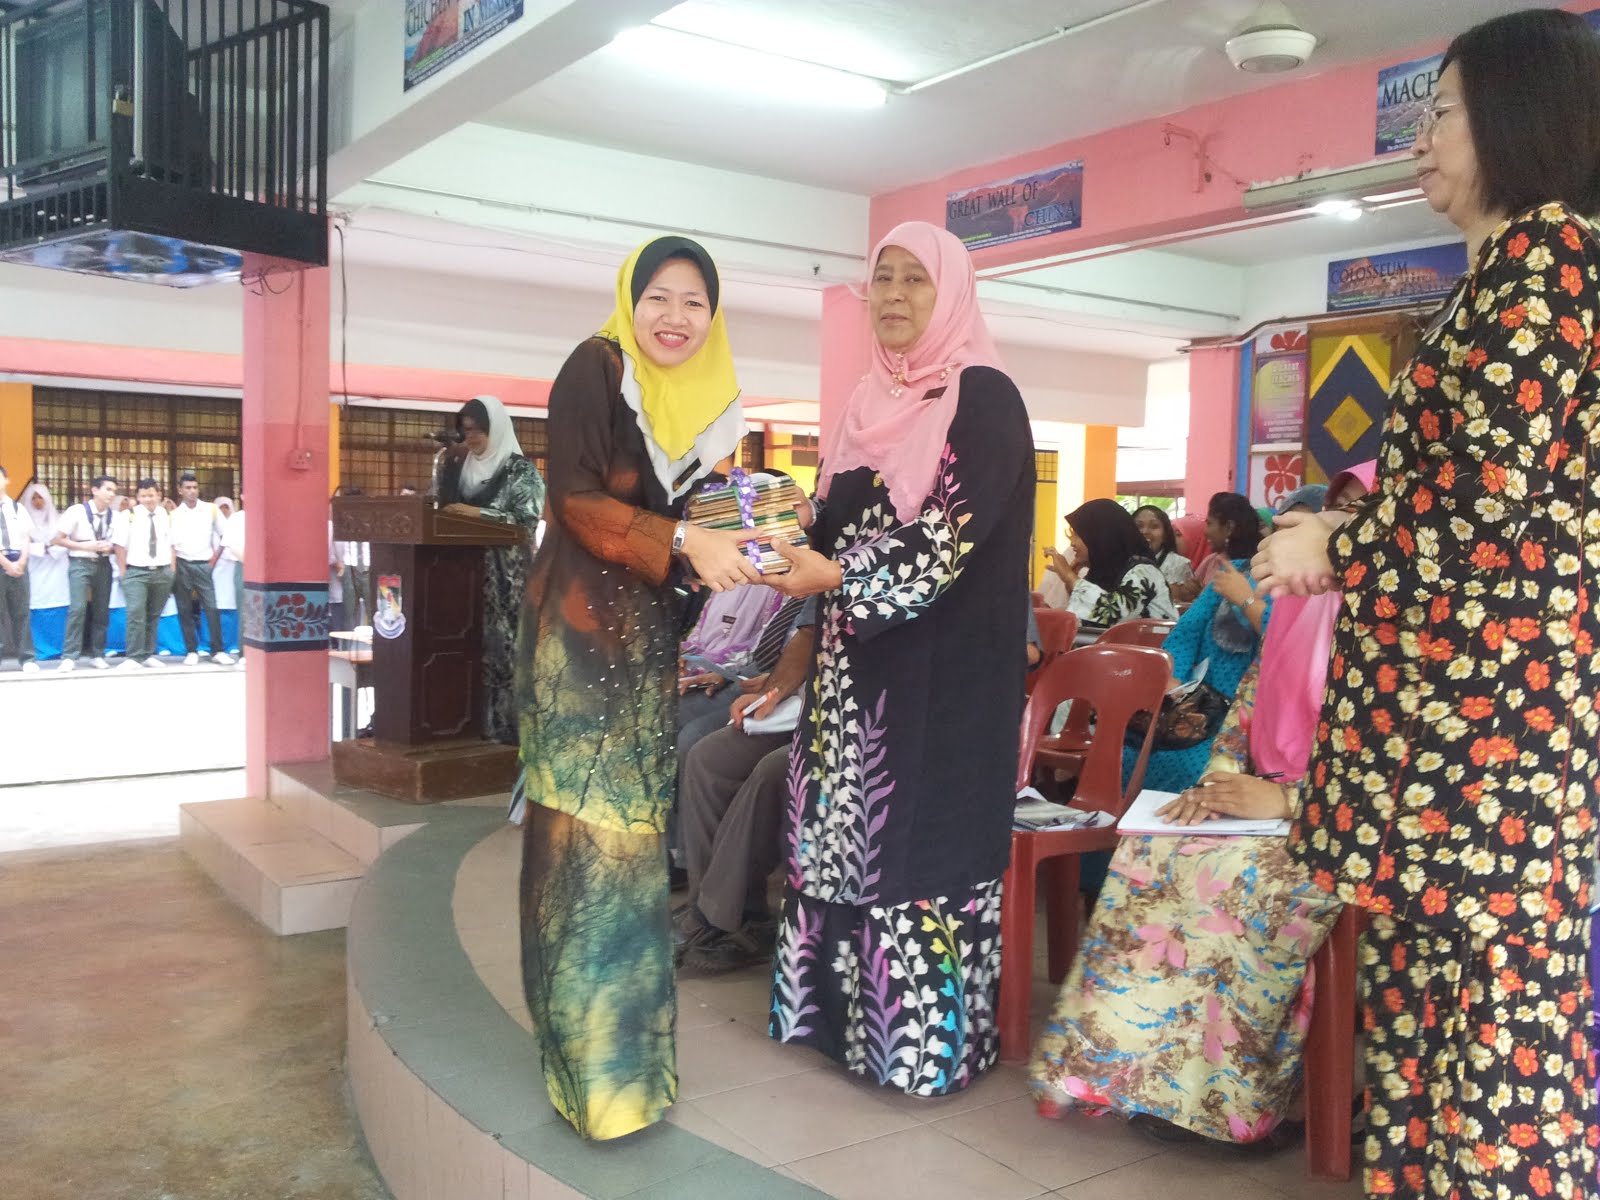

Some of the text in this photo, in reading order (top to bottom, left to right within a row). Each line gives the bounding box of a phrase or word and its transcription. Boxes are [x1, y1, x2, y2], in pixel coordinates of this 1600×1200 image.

[950, 180, 1039, 219] GREAT WALL OF
[1023, 200, 1077, 228] CHINA
[1330, 260, 1409, 285] COLOSSEUM
